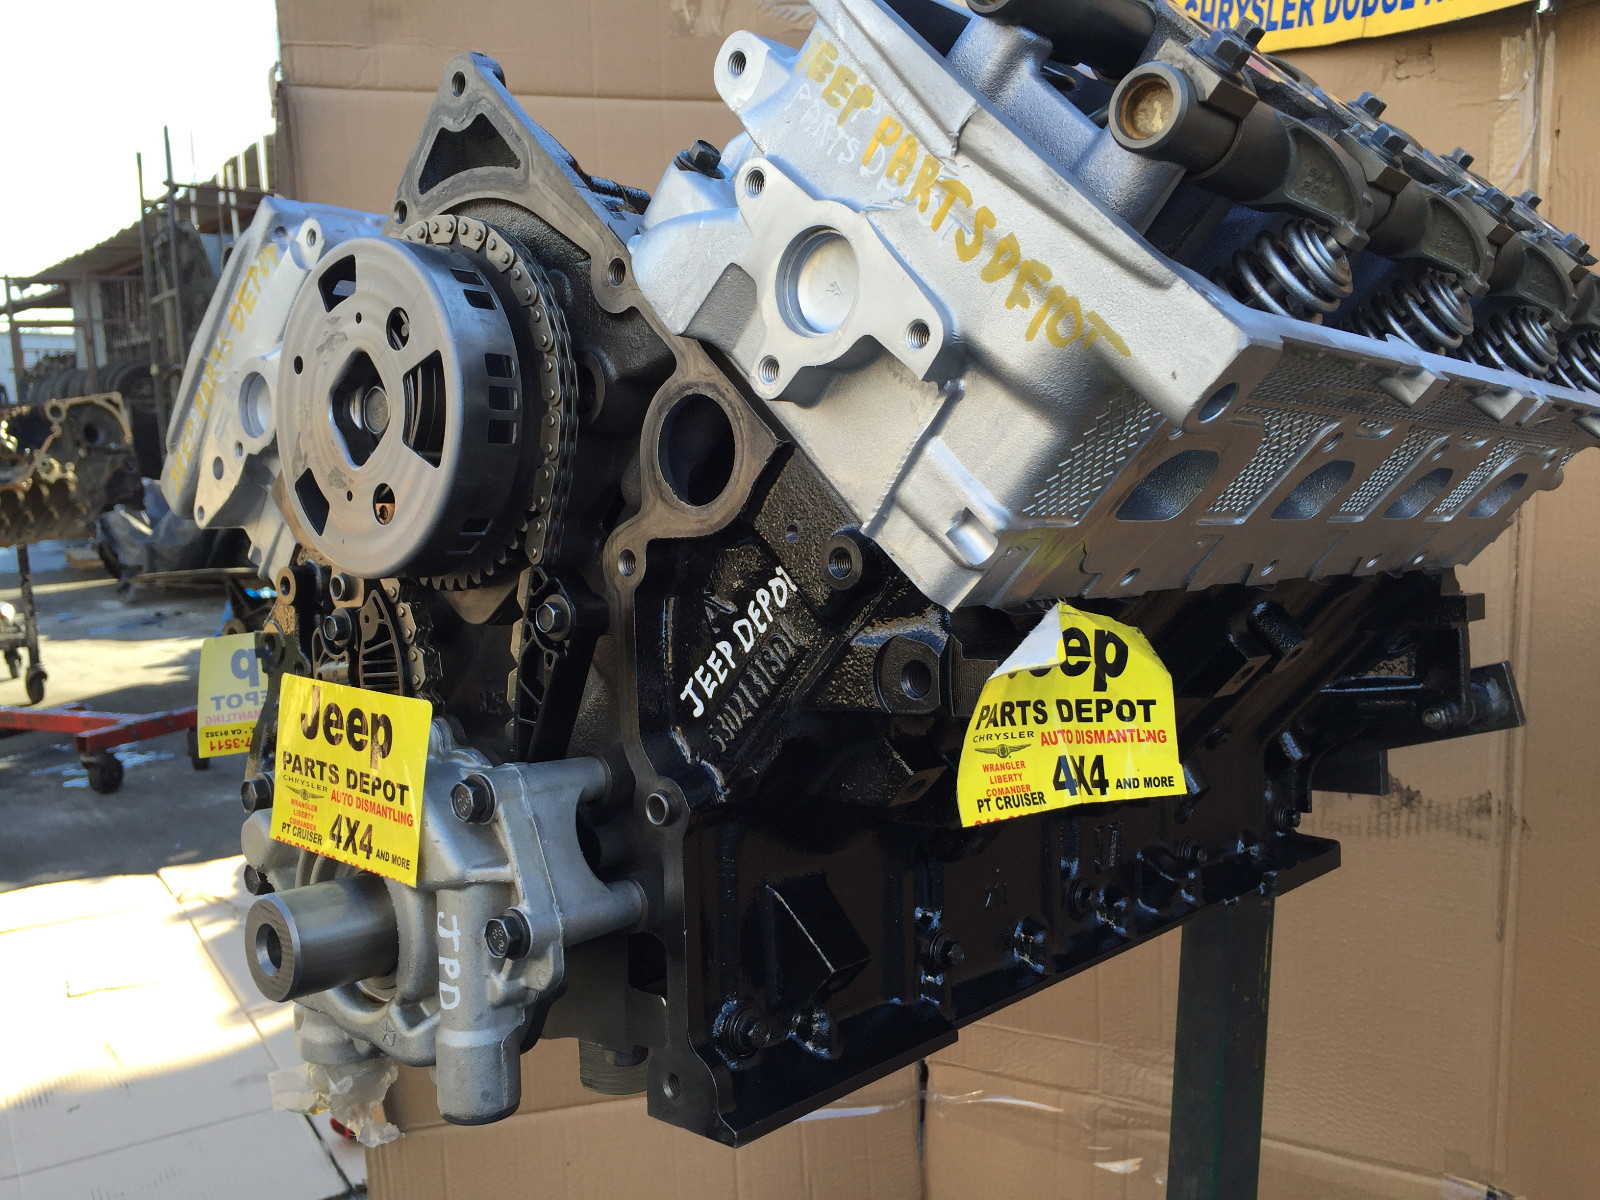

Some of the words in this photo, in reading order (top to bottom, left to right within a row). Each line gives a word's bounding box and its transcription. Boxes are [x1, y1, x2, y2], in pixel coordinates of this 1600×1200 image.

[794, 29, 875, 127] JEEP
[861, 114, 997, 262] PARTS
[195, 328, 234, 420] PARTS
[228, 245, 280, 334] DEPOT
[680, 640, 736, 718] JEEP
[974, 699, 1048, 730] PARTS
[1055, 699, 1157, 723] DEPOT
[300, 685, 393, 770] Jeep
[972, 730, 1035, 743] CHRYSLER
[1040, 729, 1074, 747] AUTO
[1075, 728, 1167, 745] DISMANTLING
[982, 760, 1026, 773] WRANGLER
[1052, 755, 1109, 796] 4X4
[282, 751, 340, 785] PARTS
[346, 768, 410, 806] DEPOT
[282, 774, 328, 792] CHRYSLER
[989, 773, 1023, 785] LIBERTY
[1115, 776, 1140, 790] AND
[1143, 776, 1175, 788] MORE
[986, 784, 1031, 797] COMANDER
[290, 798, 318, 812] WRANGLER
[330, 789, 354, 807] AUTO
[355, 796, 414, 828] DISMANTLING
[977, 798, 991, 813] PT
[995, 791, 1047, 811] CRUISER
[289, 817, 317, 832] COMANDER
[293, 809, 315, 821] LIBERTY
[281, 821, 292, 833] PT
[292, 826, 323, 846] CRUISER
[328, 813, 374, 860] 4X4
[375, 848, 390, 862] AND
[391, 853, 411, 870] MORE
[437, 911, 461, 1010] JPD
